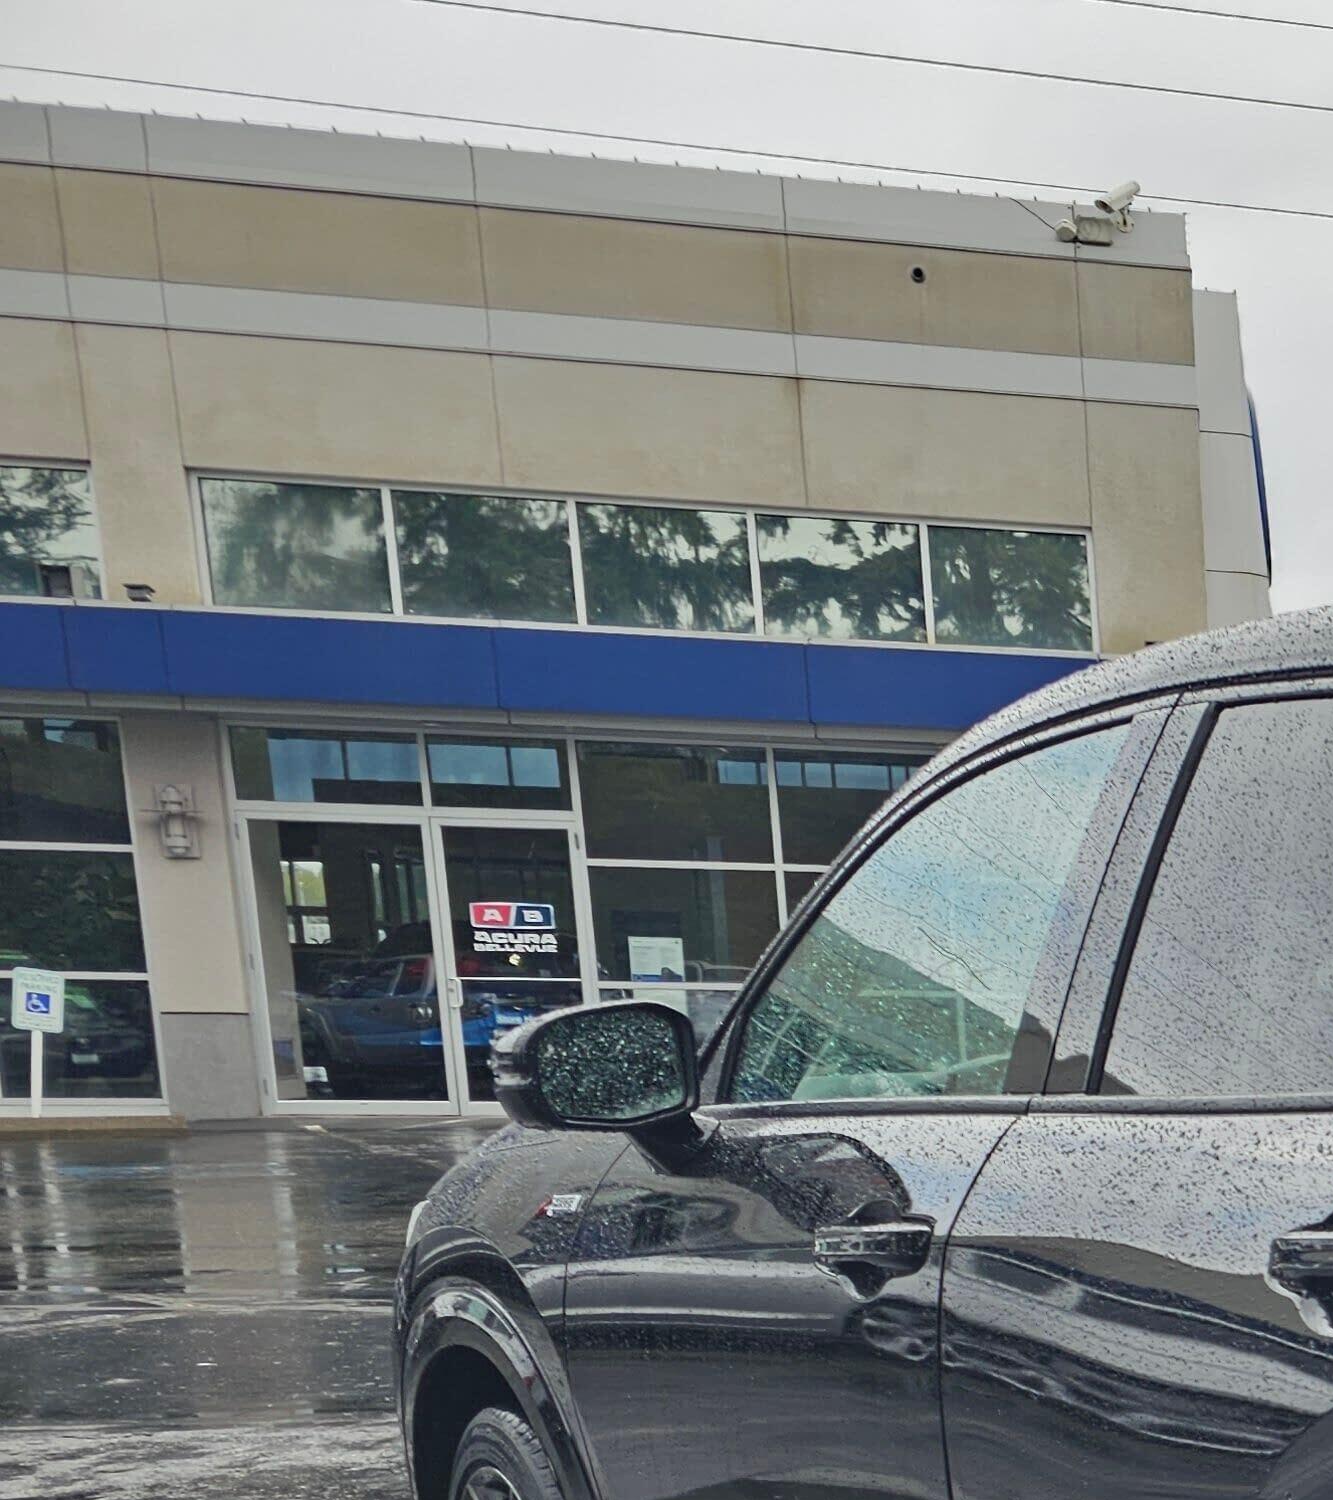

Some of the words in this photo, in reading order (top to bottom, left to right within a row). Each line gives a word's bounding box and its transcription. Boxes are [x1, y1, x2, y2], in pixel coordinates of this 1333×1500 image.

[483, 909, 504, 922] A
[522, 910, 544, 923] B
[473, 931, 558, 945] ACURA
